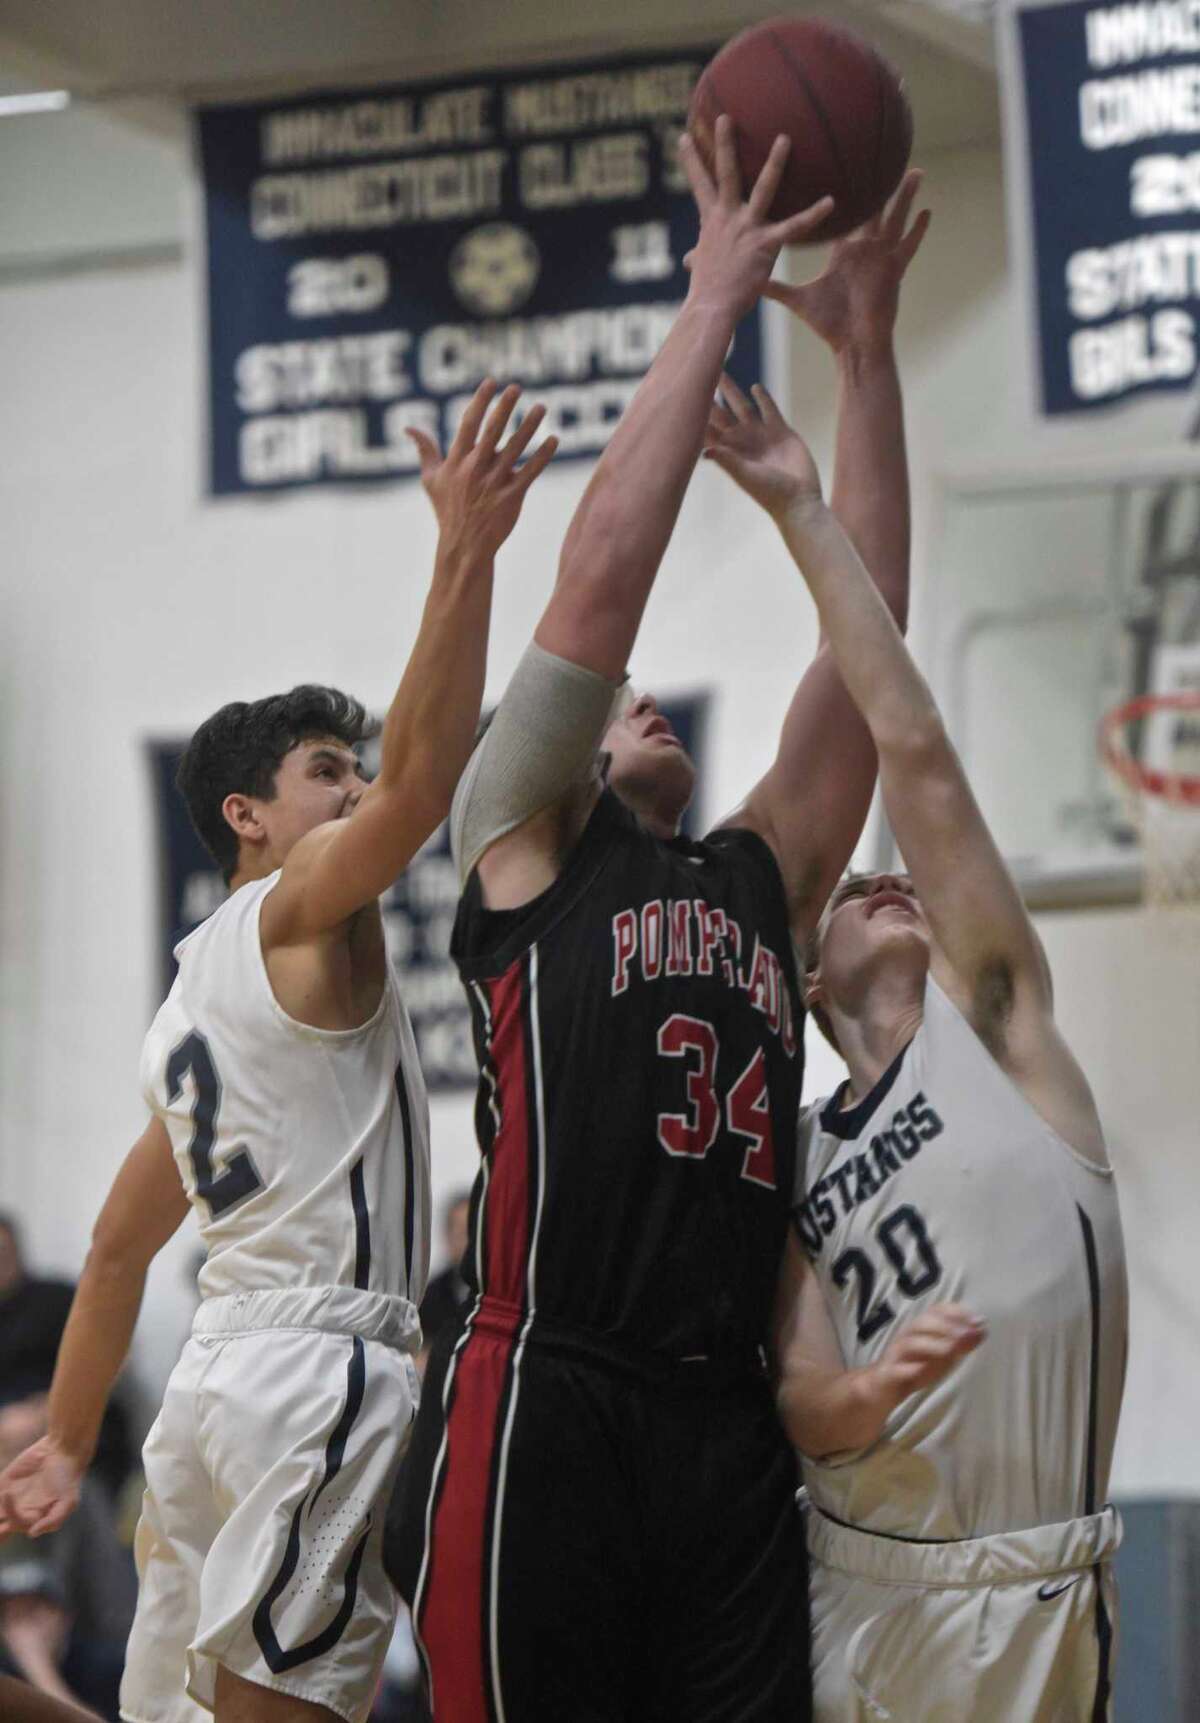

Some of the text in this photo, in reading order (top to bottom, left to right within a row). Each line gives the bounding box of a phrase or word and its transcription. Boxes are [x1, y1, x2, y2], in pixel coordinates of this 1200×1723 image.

[234, 301, 690, 415] STATE CHAMPIO
[164, 1027, 268, 1222] 2
[656, 1012, 777, 1190] 34
[795, 1089, 945, 1263] USTANGS
[831, 1202, 943, 1343] 20
